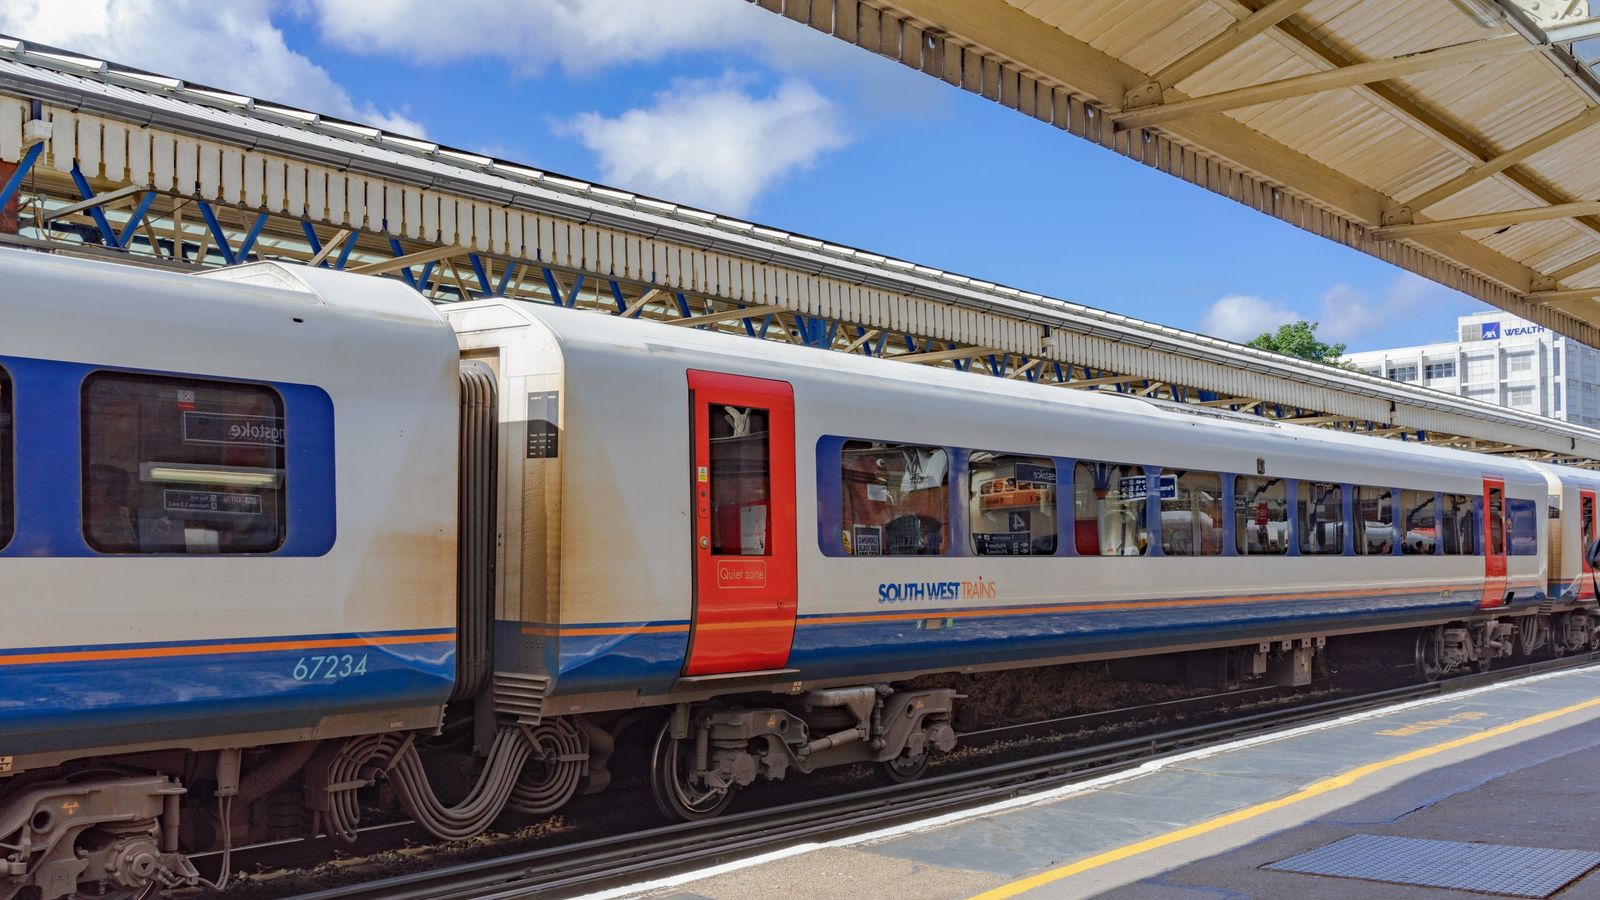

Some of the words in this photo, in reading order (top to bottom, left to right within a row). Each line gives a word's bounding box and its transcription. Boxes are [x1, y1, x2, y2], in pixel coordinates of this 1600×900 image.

[1482, 331, 1497, 339] AXA
[1504, 325, 1545, 337] WEALTH
[720, 567, 744, 580] Quiet
[745, 571, 764, 580] zone
[879, 582, 925, 603] SOUTH
[927, 581, 960, 600] WEST
[961, 576, 996, 599] TRAINS
[292, 652, 368, 681] 67234
